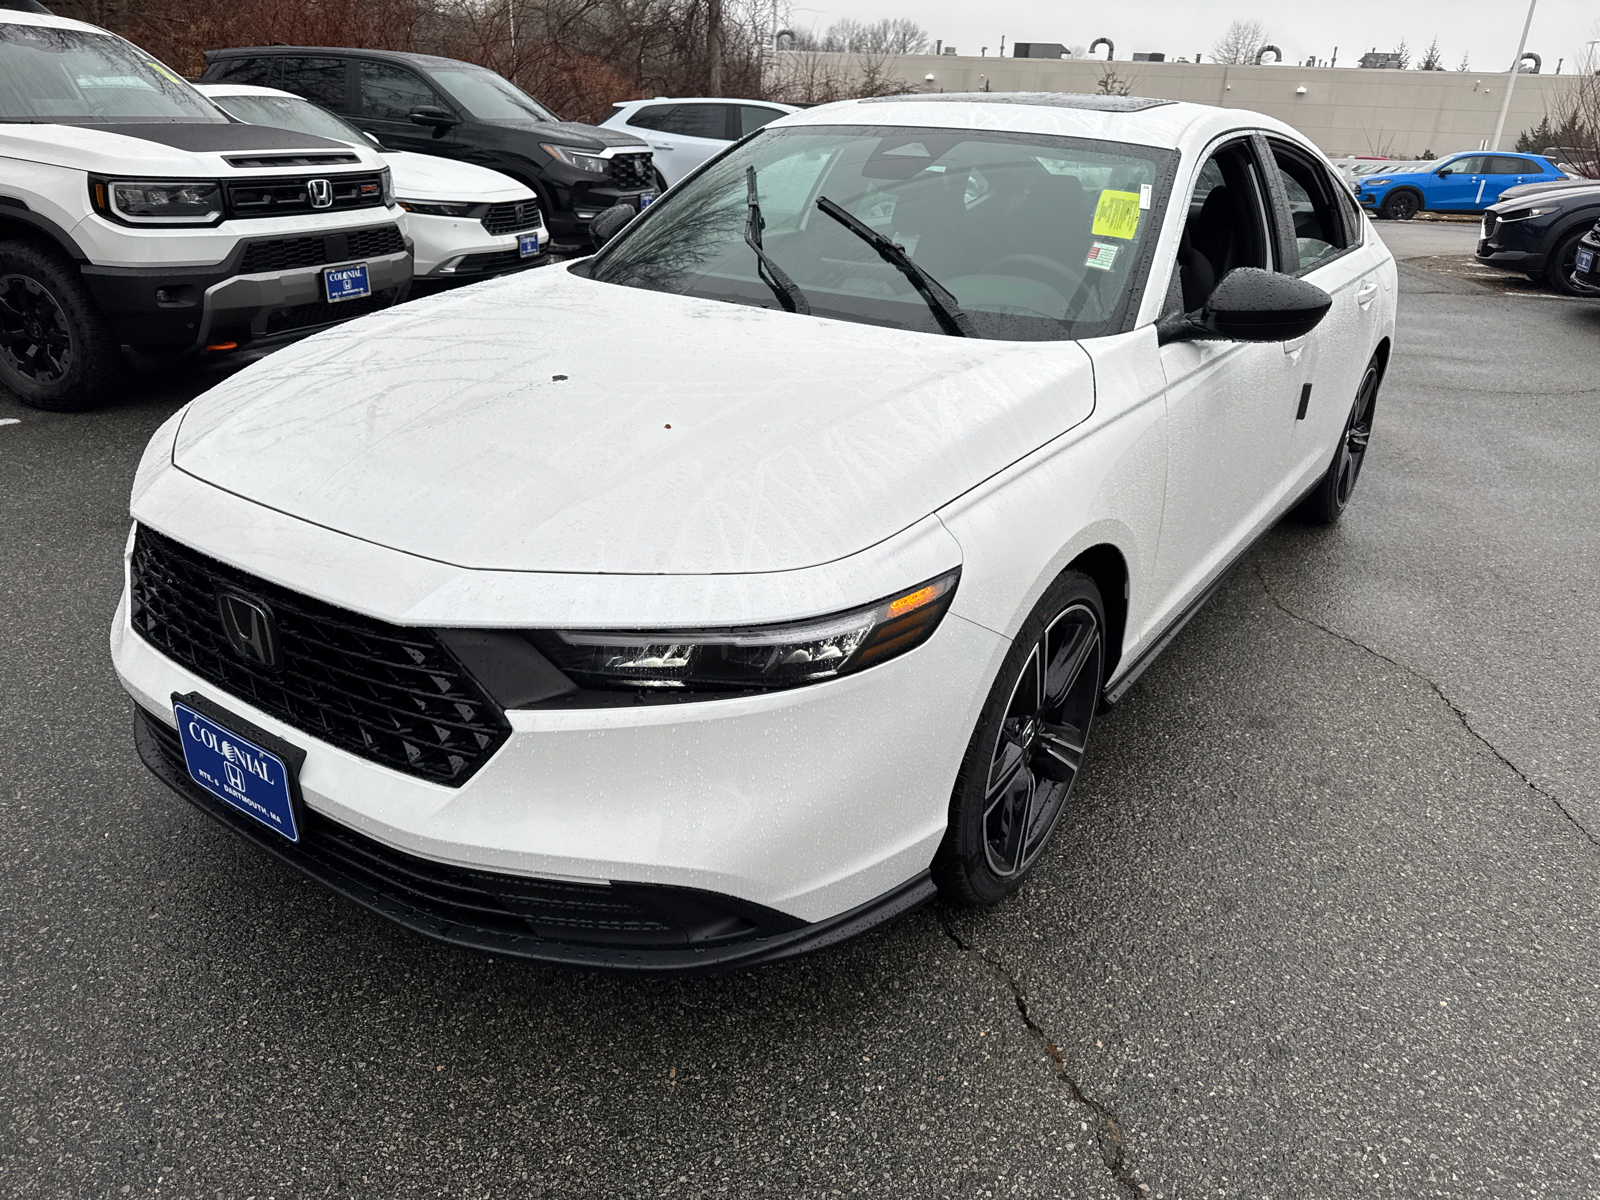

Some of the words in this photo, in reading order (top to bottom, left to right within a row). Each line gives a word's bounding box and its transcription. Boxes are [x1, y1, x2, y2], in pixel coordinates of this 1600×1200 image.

[329, 269, 363, 282] COLONIAL
[188, 721, 275, 785] COLONIAL
[269, 811, 283, 824] MA
